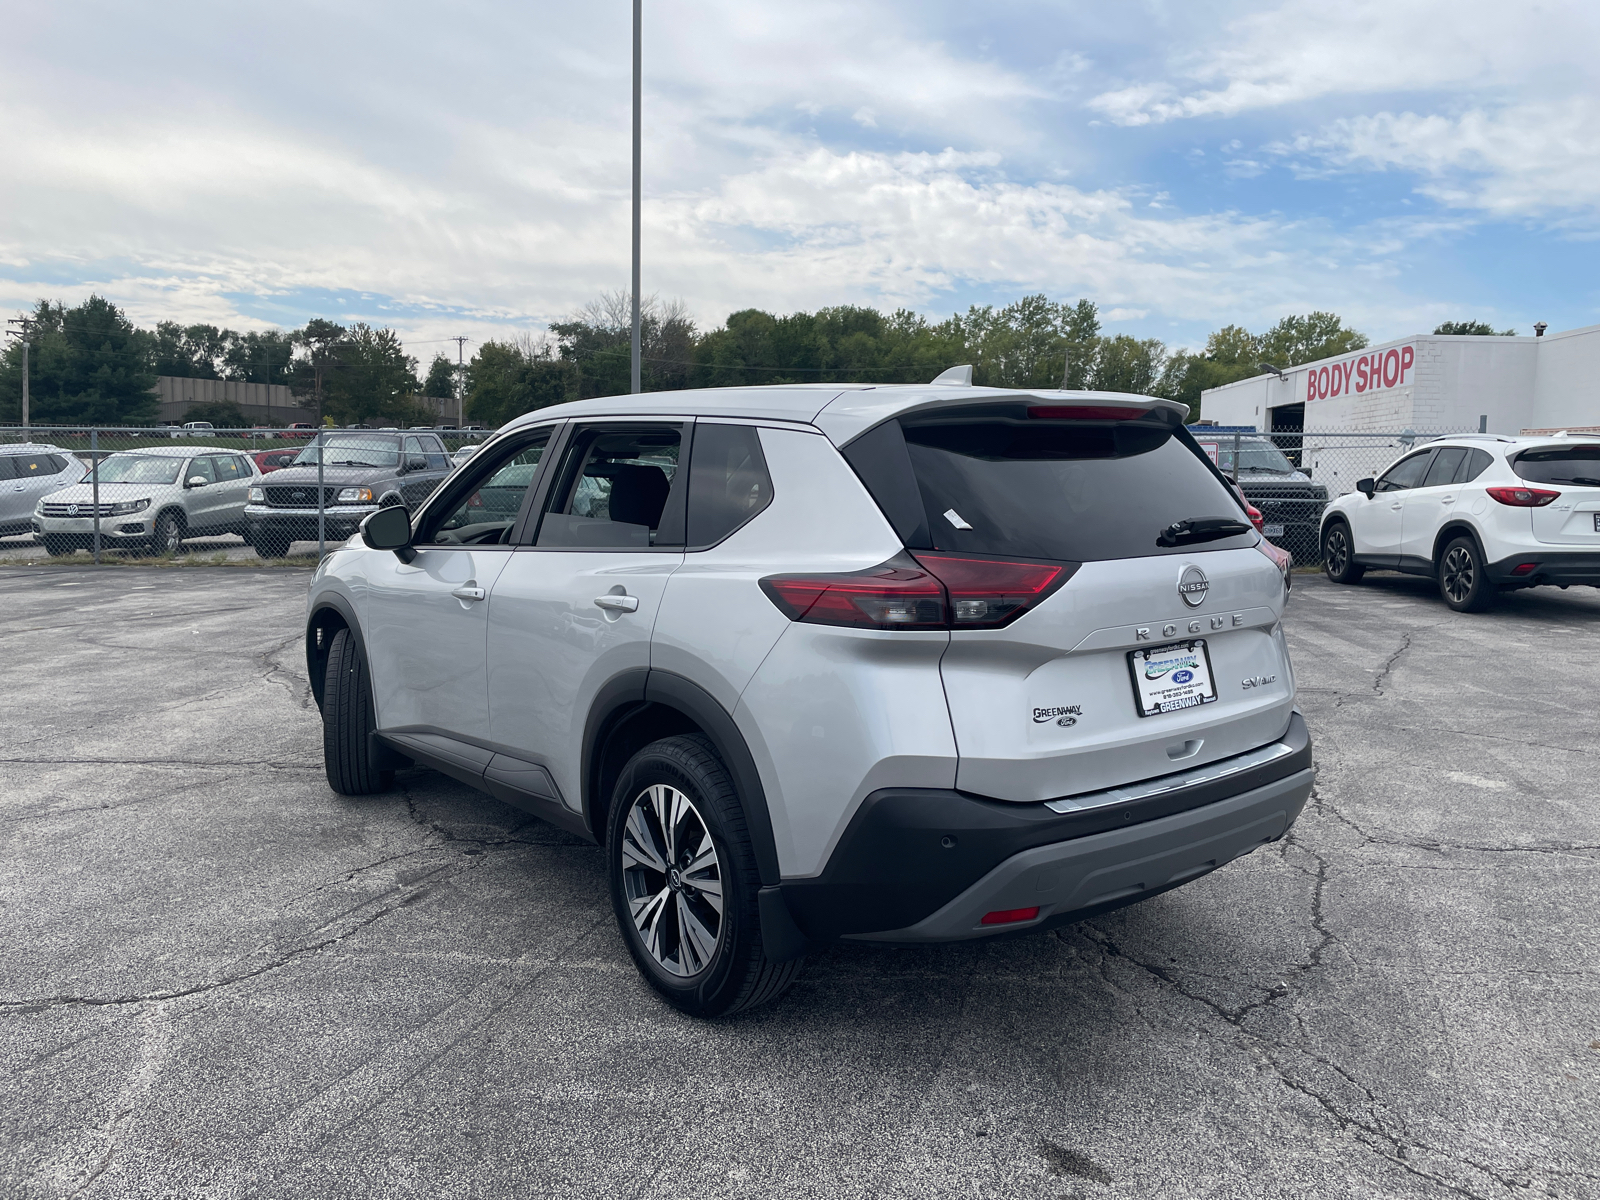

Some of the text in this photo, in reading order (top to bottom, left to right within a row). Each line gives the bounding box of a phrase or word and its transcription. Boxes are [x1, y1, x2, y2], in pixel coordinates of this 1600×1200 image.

[1180, 582, 1210, 592] NISSAN
[1136, 614, 1243, 641] ROGUE
[1144, 655, 1197, 675] GREENWAY
[1033, 704, 1081, 719] GREENWAY
[1160, 695, 1202, 712] GREENWAY
